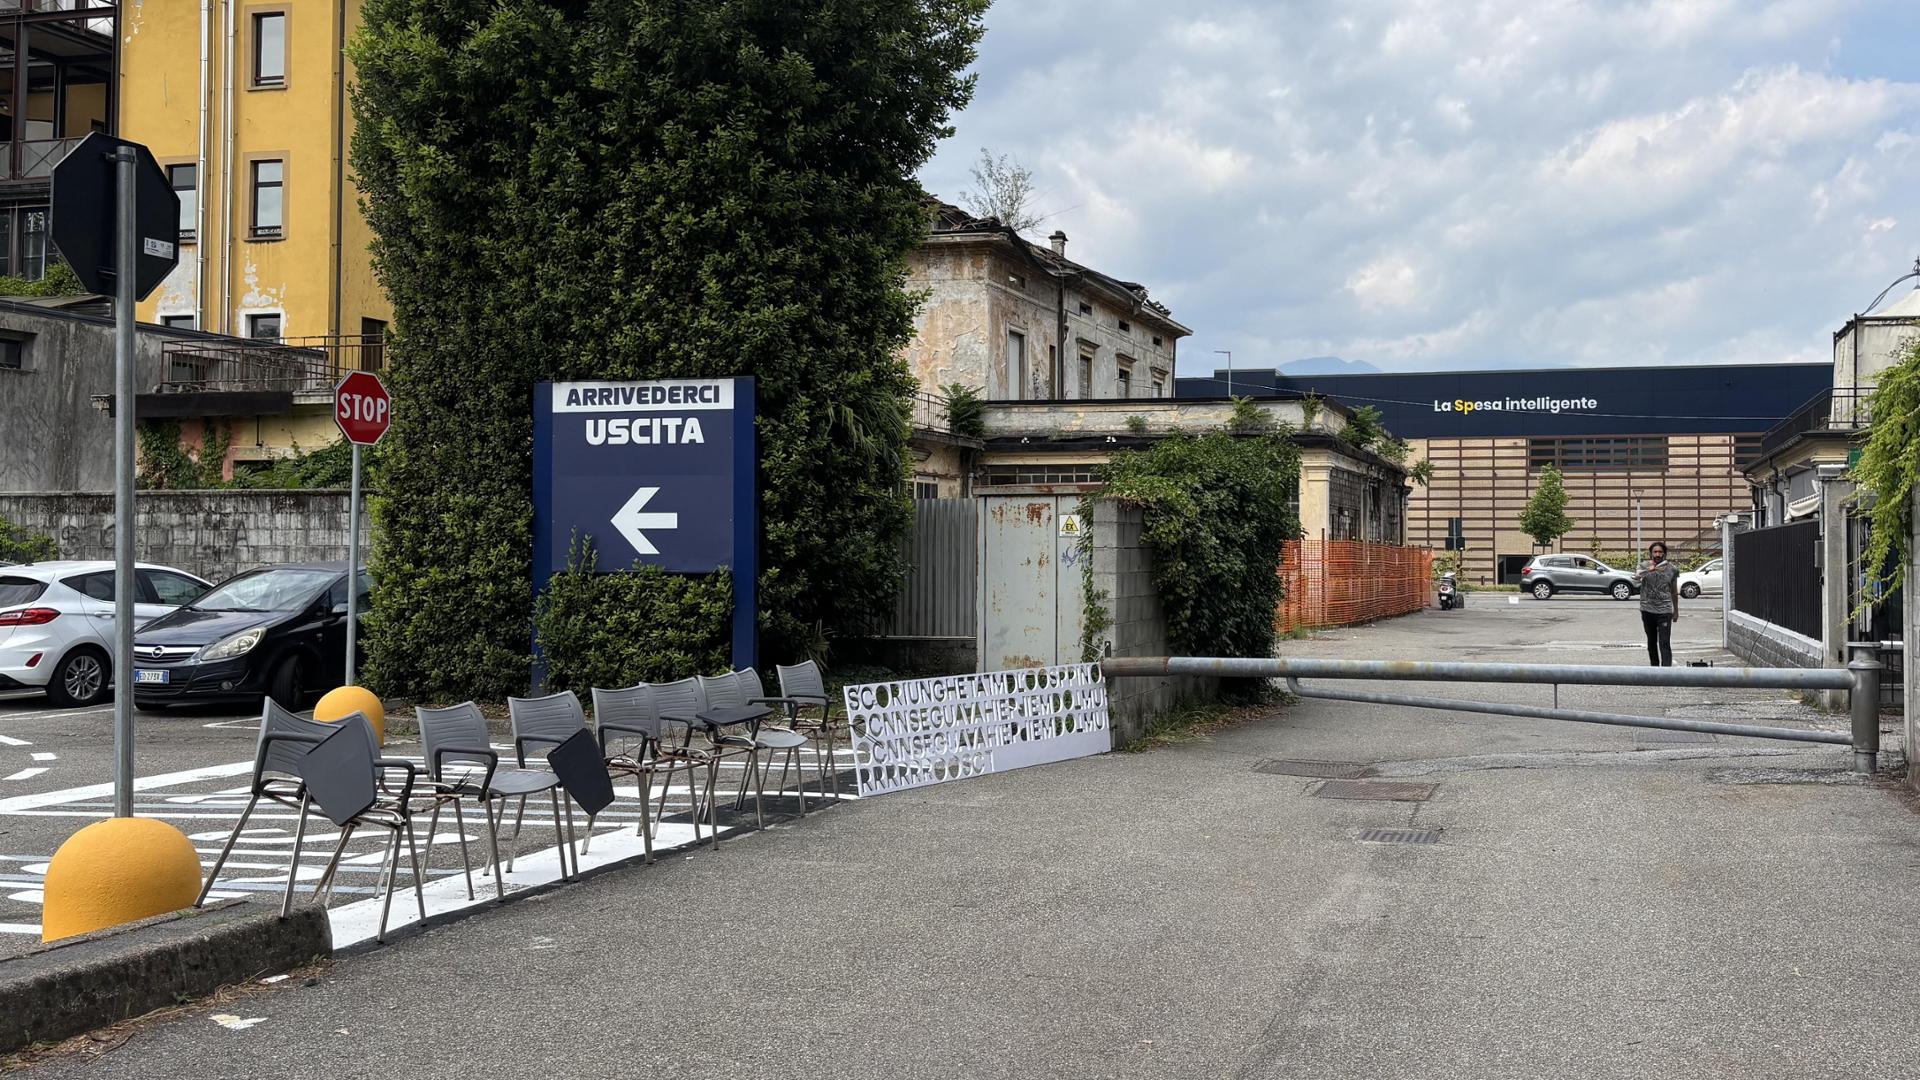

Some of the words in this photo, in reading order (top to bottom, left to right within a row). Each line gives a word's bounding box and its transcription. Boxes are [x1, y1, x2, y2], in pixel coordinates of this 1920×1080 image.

[340, 392, 387, 424] STOP
[566, 385, 720, 407] ARRIVEDERCI
[1434, 400, 1451, 412] La
[1454, 399, 1502, 415] Spesa
[1505, 397, 1598, 413] intelligente
[585, 417, 705, 446] USCITA
